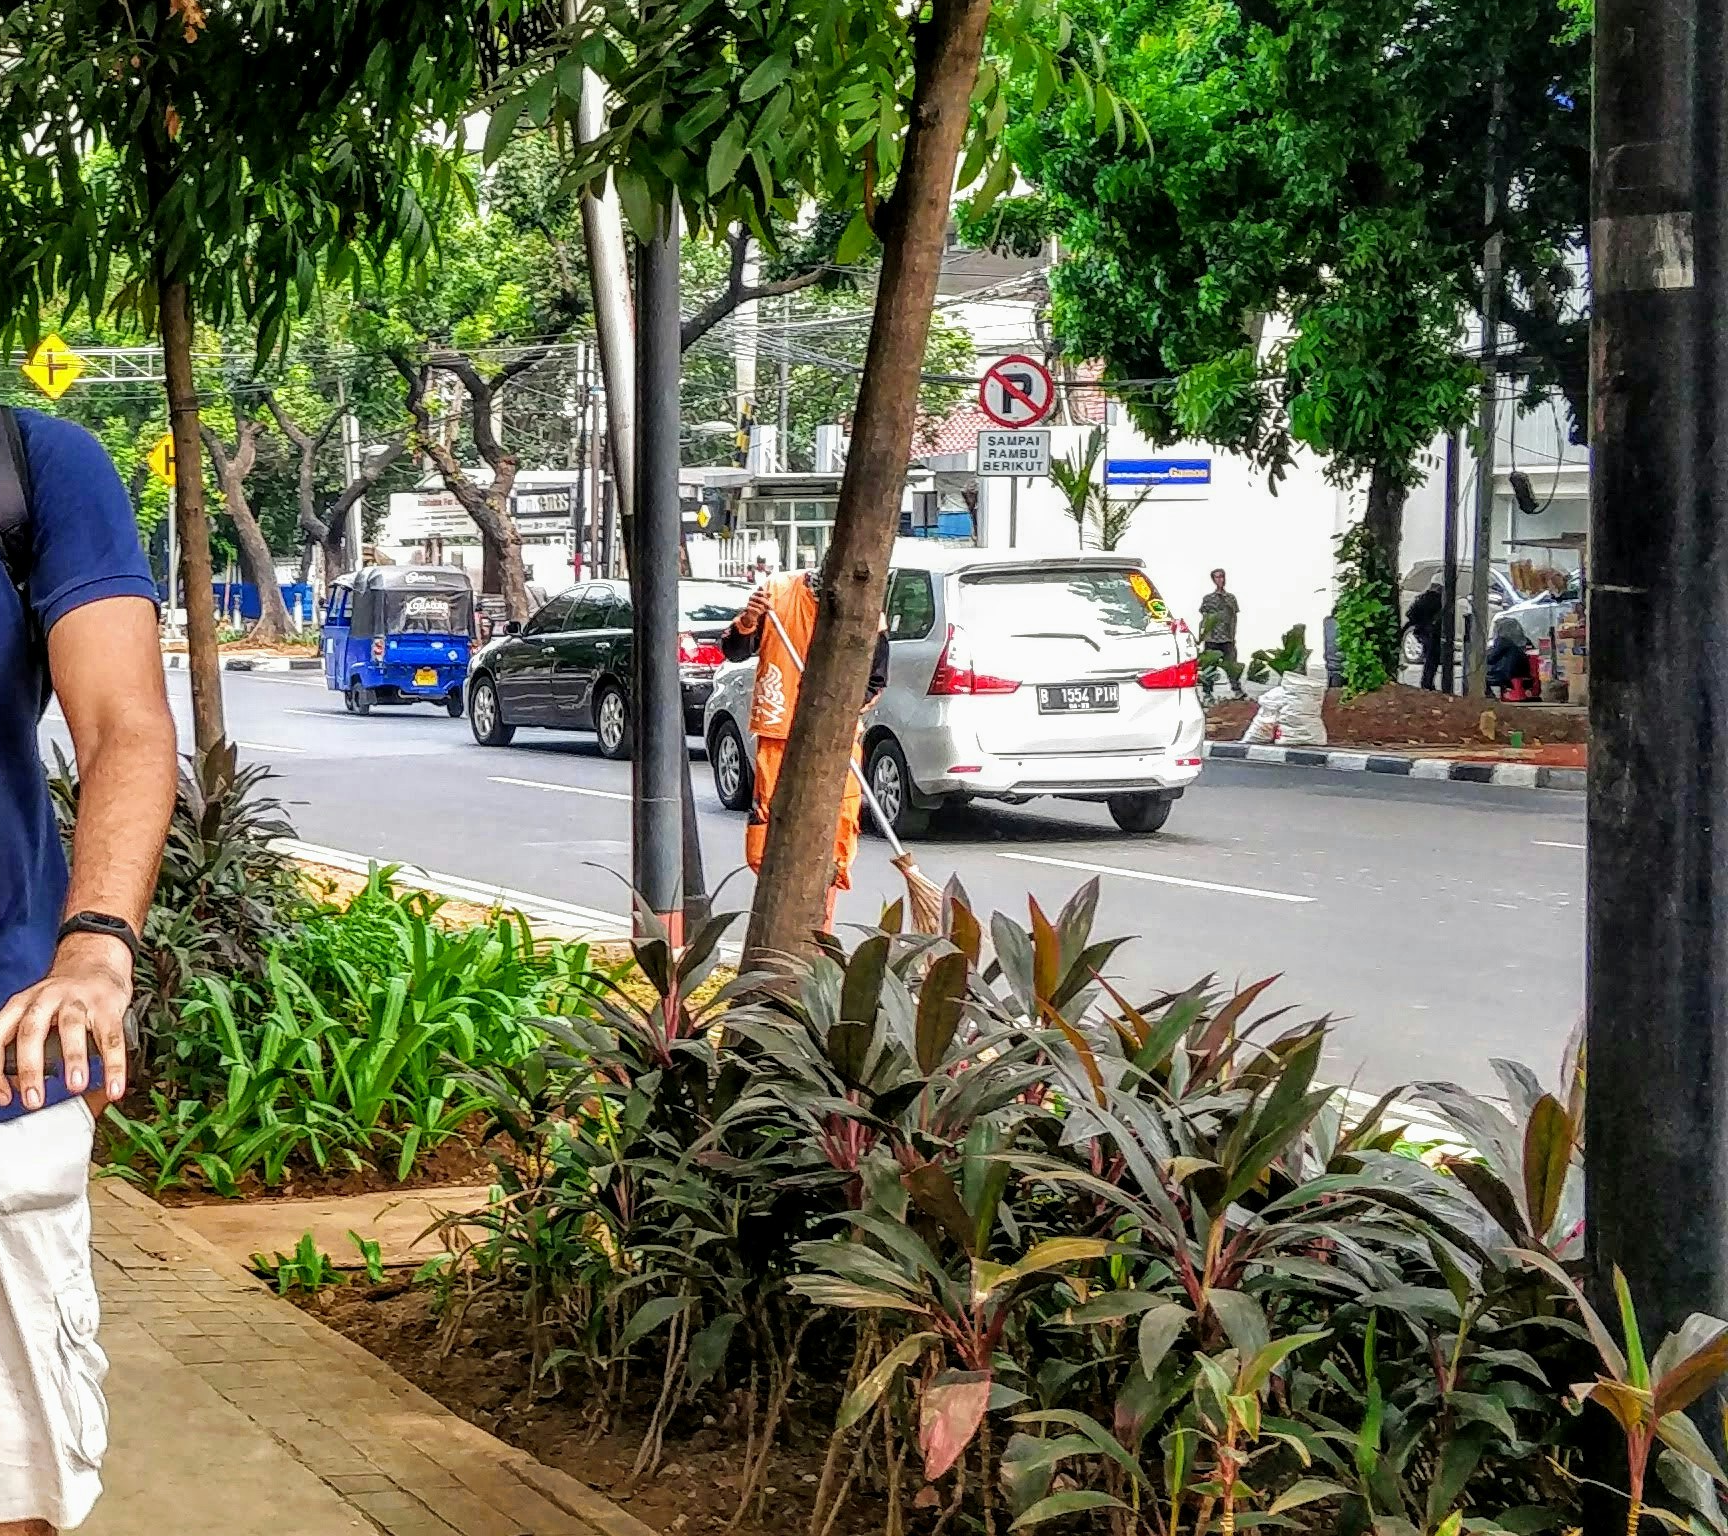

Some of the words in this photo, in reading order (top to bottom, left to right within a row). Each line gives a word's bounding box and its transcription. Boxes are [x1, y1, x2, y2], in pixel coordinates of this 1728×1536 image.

[1002, 373, 1032, 414] P
[987, 436, 1040, 446] SAMPAI
[988, 448, 1039, 459] RAMBU
[983, 461, 1044, 471] BERIKUT
[1040, 688, 1049, 704] B
[1061, 687, 1090, 703] 1554
[1094, 686, 1118, 702] PIH
